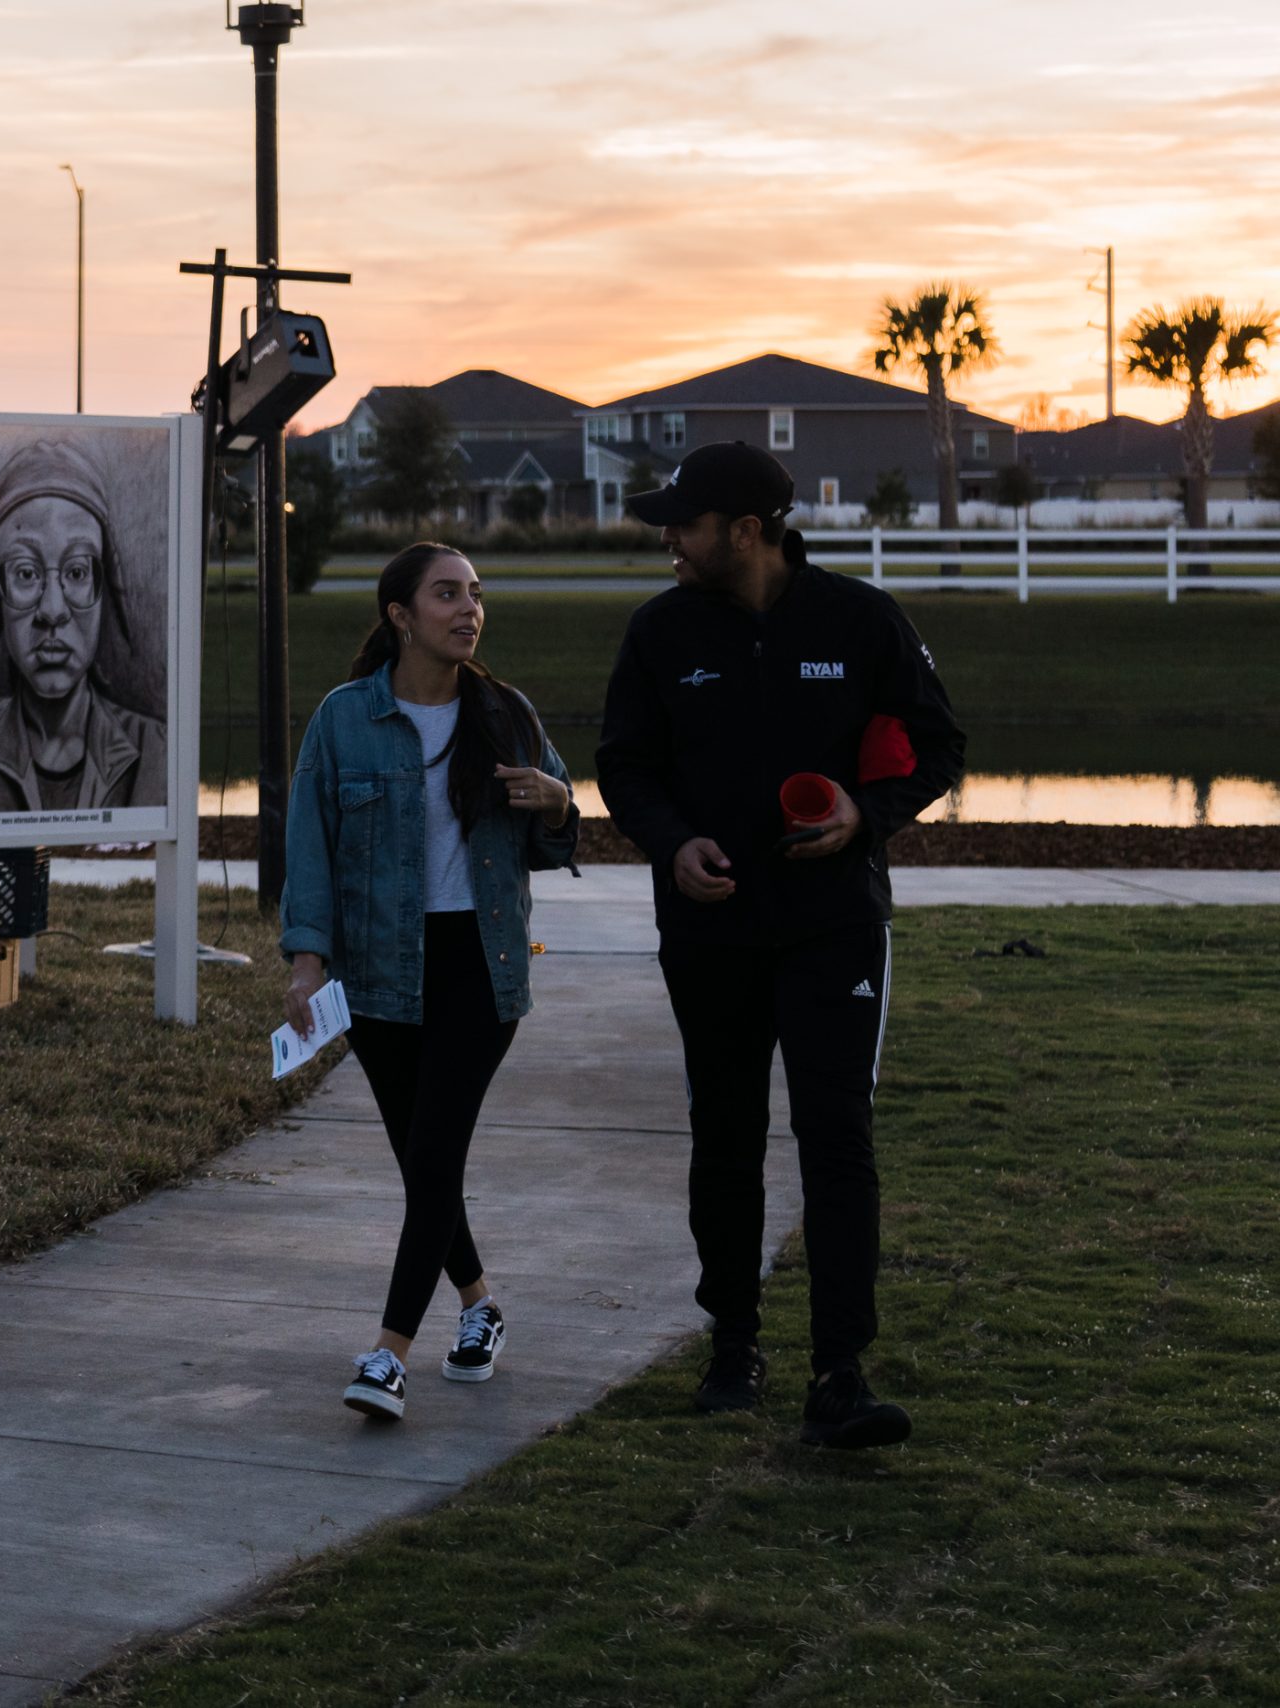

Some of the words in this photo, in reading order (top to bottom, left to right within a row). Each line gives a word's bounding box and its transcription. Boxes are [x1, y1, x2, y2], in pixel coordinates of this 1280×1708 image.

[800, 662, 844, 676] RYAN
[14, 815, 39, 824] information
[52, 815, 60, 823] the
[852, 989, 875, 997] adidas
